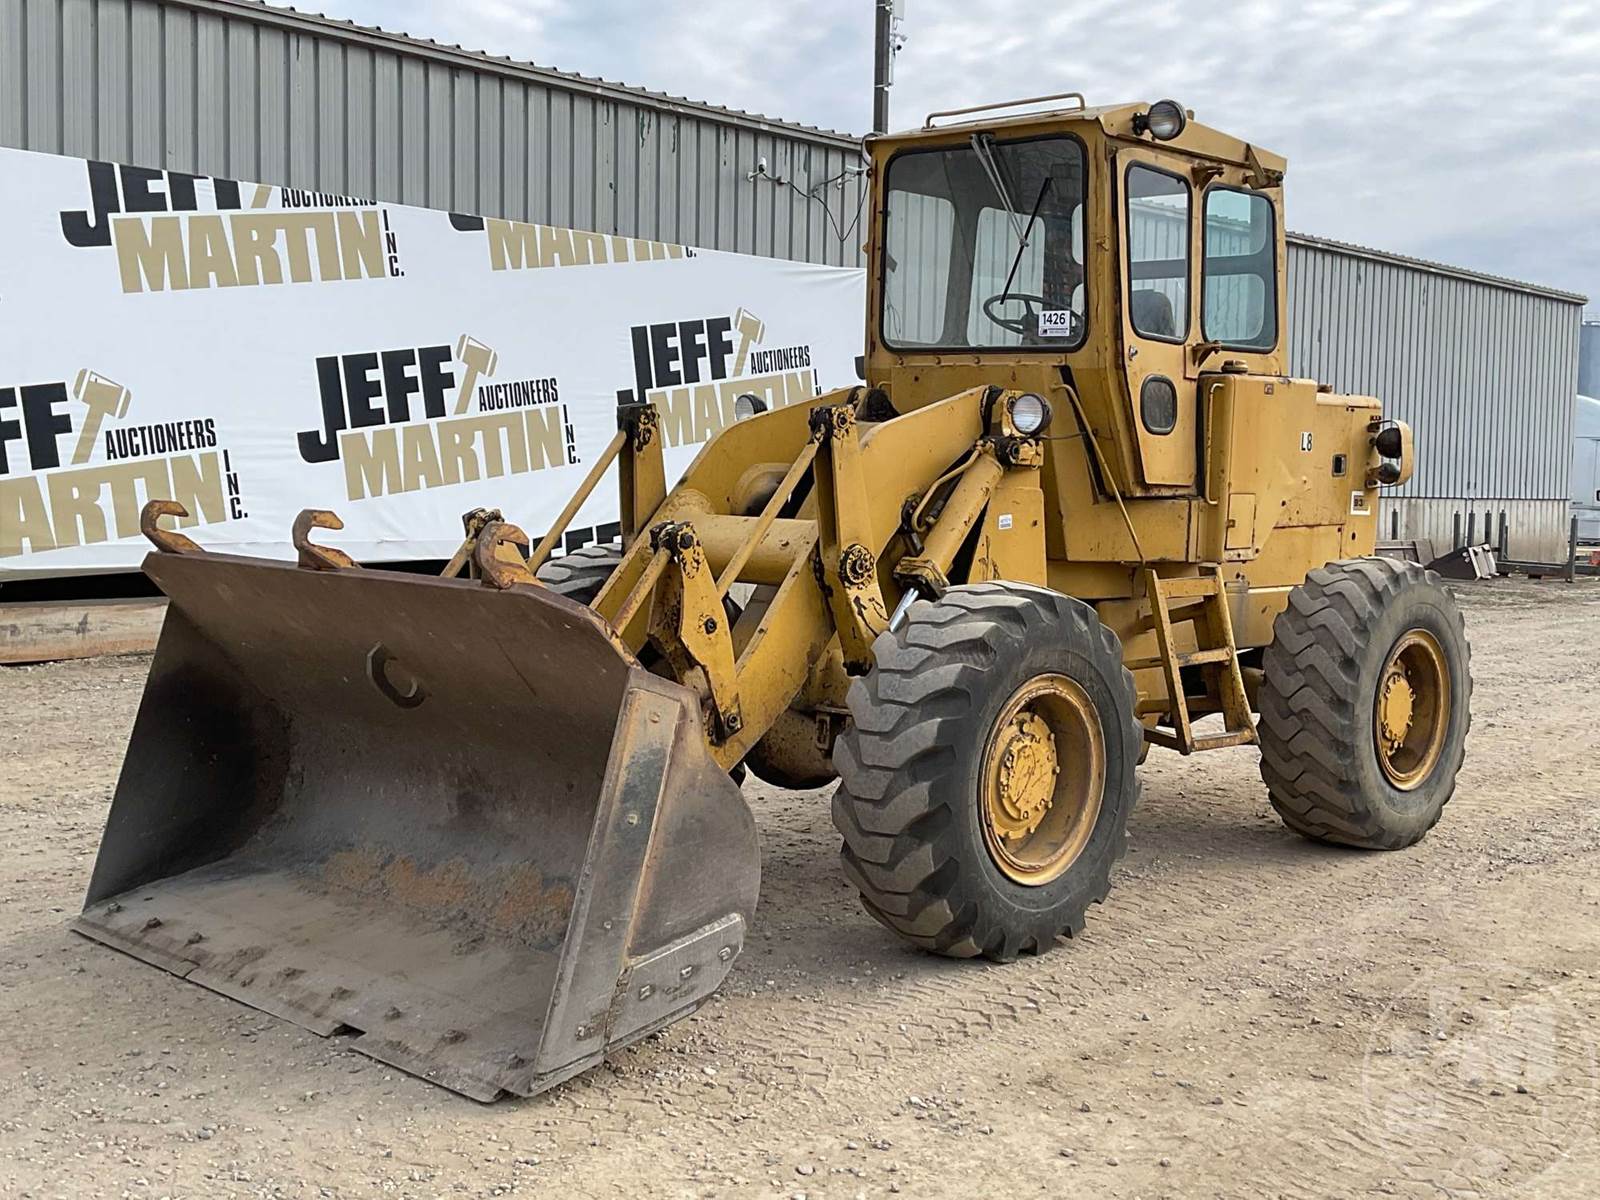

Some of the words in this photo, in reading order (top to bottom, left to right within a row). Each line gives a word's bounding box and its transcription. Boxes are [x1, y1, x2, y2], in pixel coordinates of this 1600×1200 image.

[282, 188, 379, 208] AUCTIO
[113, 210, 387, 294] MARTIN
[383, 208, 405, 278] INC.
[1042, 313, 1066, 325] 1426
[617, 317, 734, 404] JEFF
[751, 345, 811, 374] AUCTIONEERS
[297, 345, 456, 463] JEFF
[478, 378, 559, 412] AUCTIONEERS
[105, 418, 217, 460] AUCTIONEERS
[341, 406, 565, 502] MARTIN
[563, 404, 581, 465] INC.
[1300, 432, 1313, 452] L8
[223, 449, 249, 521] INC.
